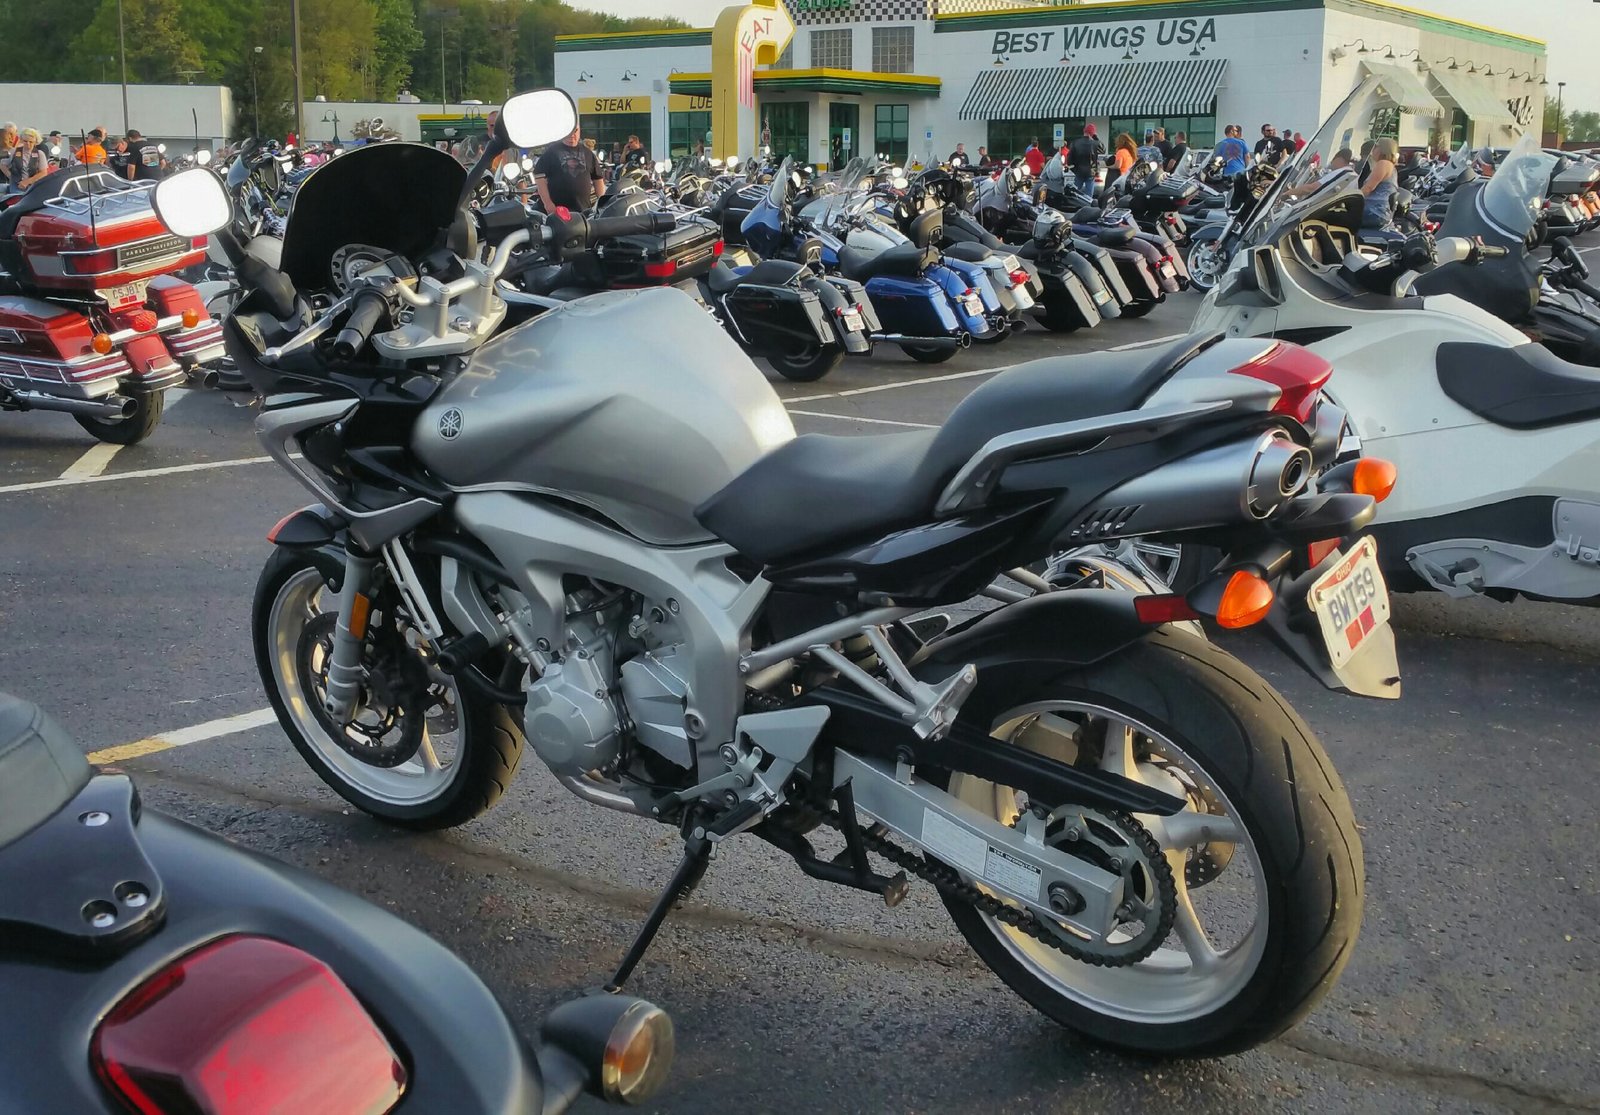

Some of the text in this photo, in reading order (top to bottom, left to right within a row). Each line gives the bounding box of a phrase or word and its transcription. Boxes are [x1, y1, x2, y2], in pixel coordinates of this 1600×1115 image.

[741, 17, 773, 54] EAT
[992, 18, 1217, 54] BEST WINGS USA
[594, 98, 633, 112] STEAK
[1335, 562, 1351, 580] OHIO
[1328, 567, 1376, 632] BWT59
